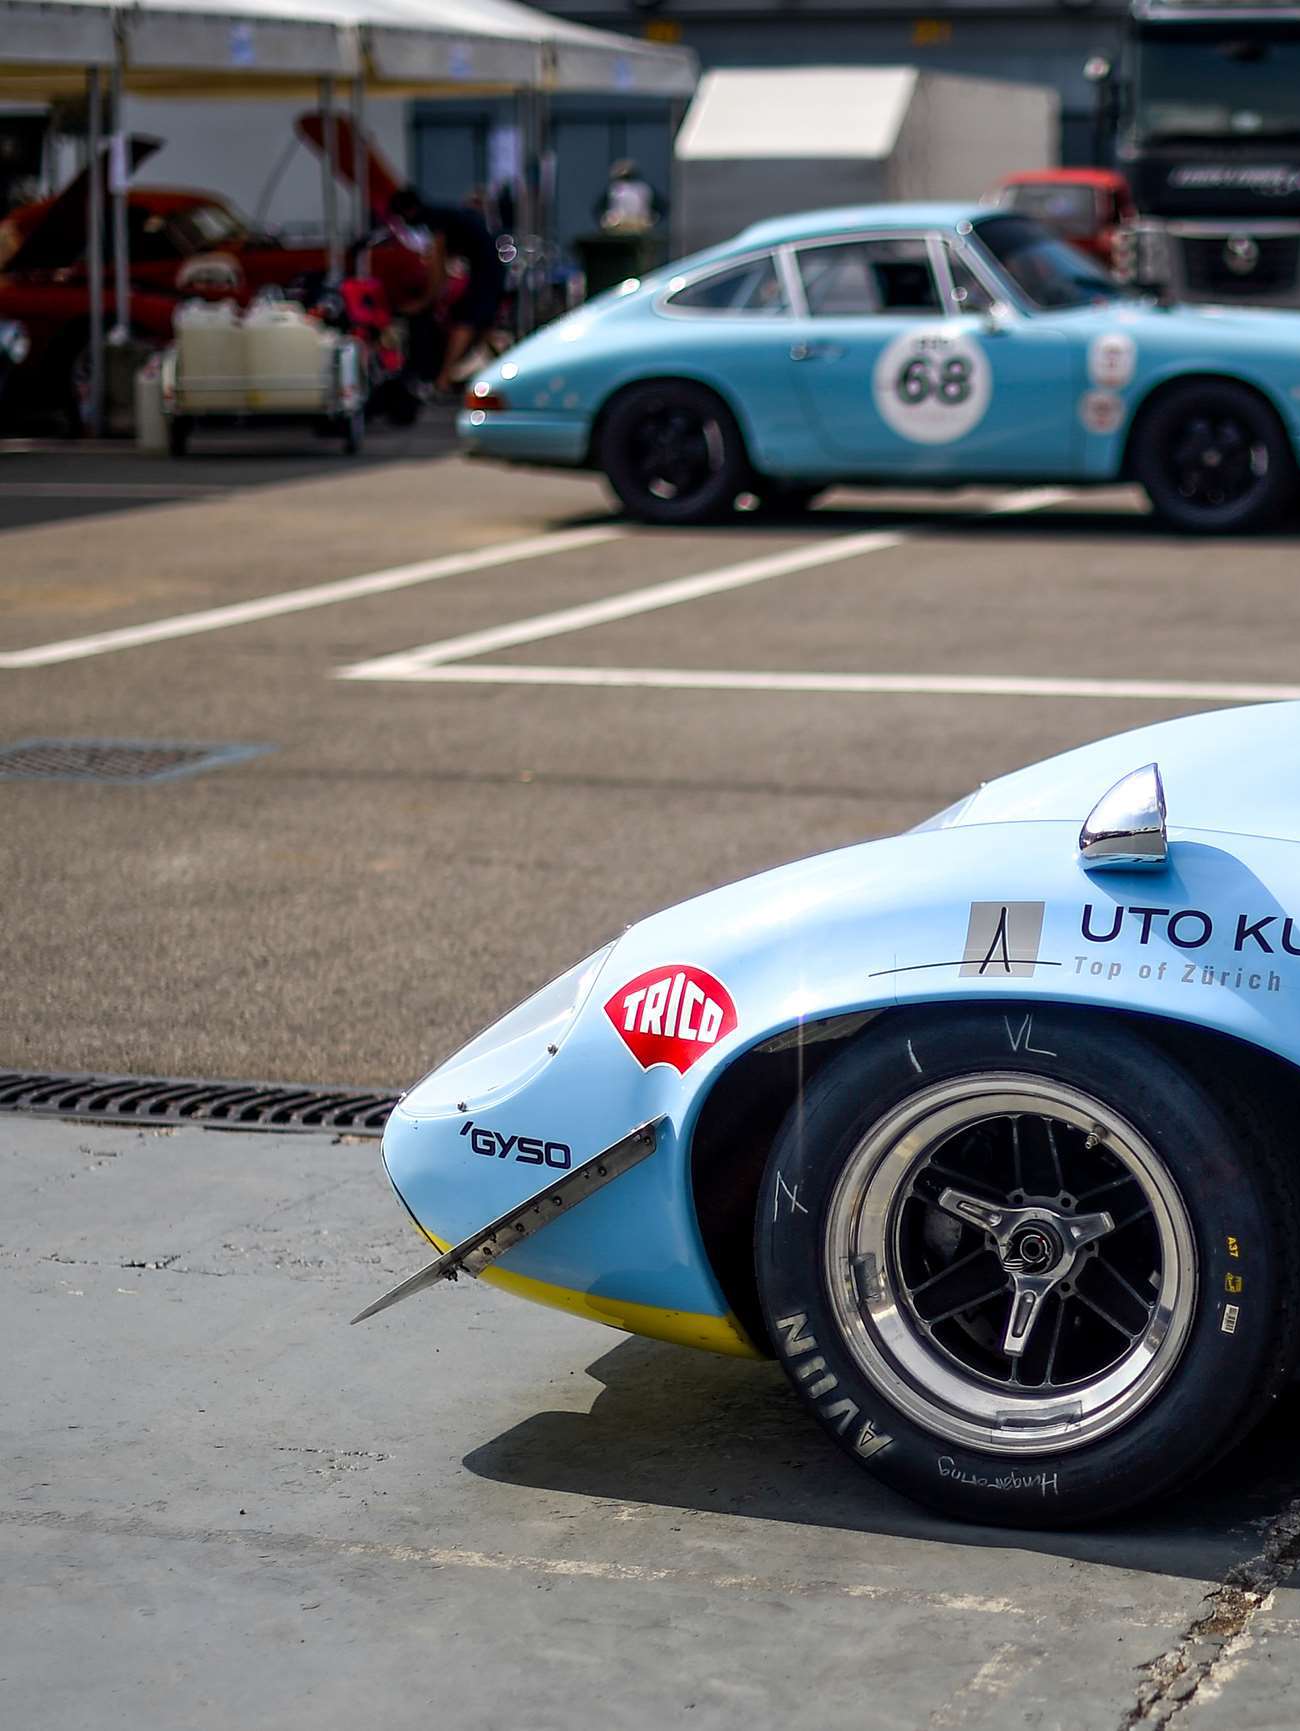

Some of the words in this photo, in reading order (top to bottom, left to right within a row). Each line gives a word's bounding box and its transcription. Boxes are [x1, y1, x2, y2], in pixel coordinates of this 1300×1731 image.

[898, 357, 973, 406] 68
[1080, 904, 1213, 948] UTO
[1074, 956, 1120, 980] Top
[1138, 961, 1167, 980] of
[1181, 963, 1282, 992] Zürich
[623, 971, 724, 1043] TRICO
